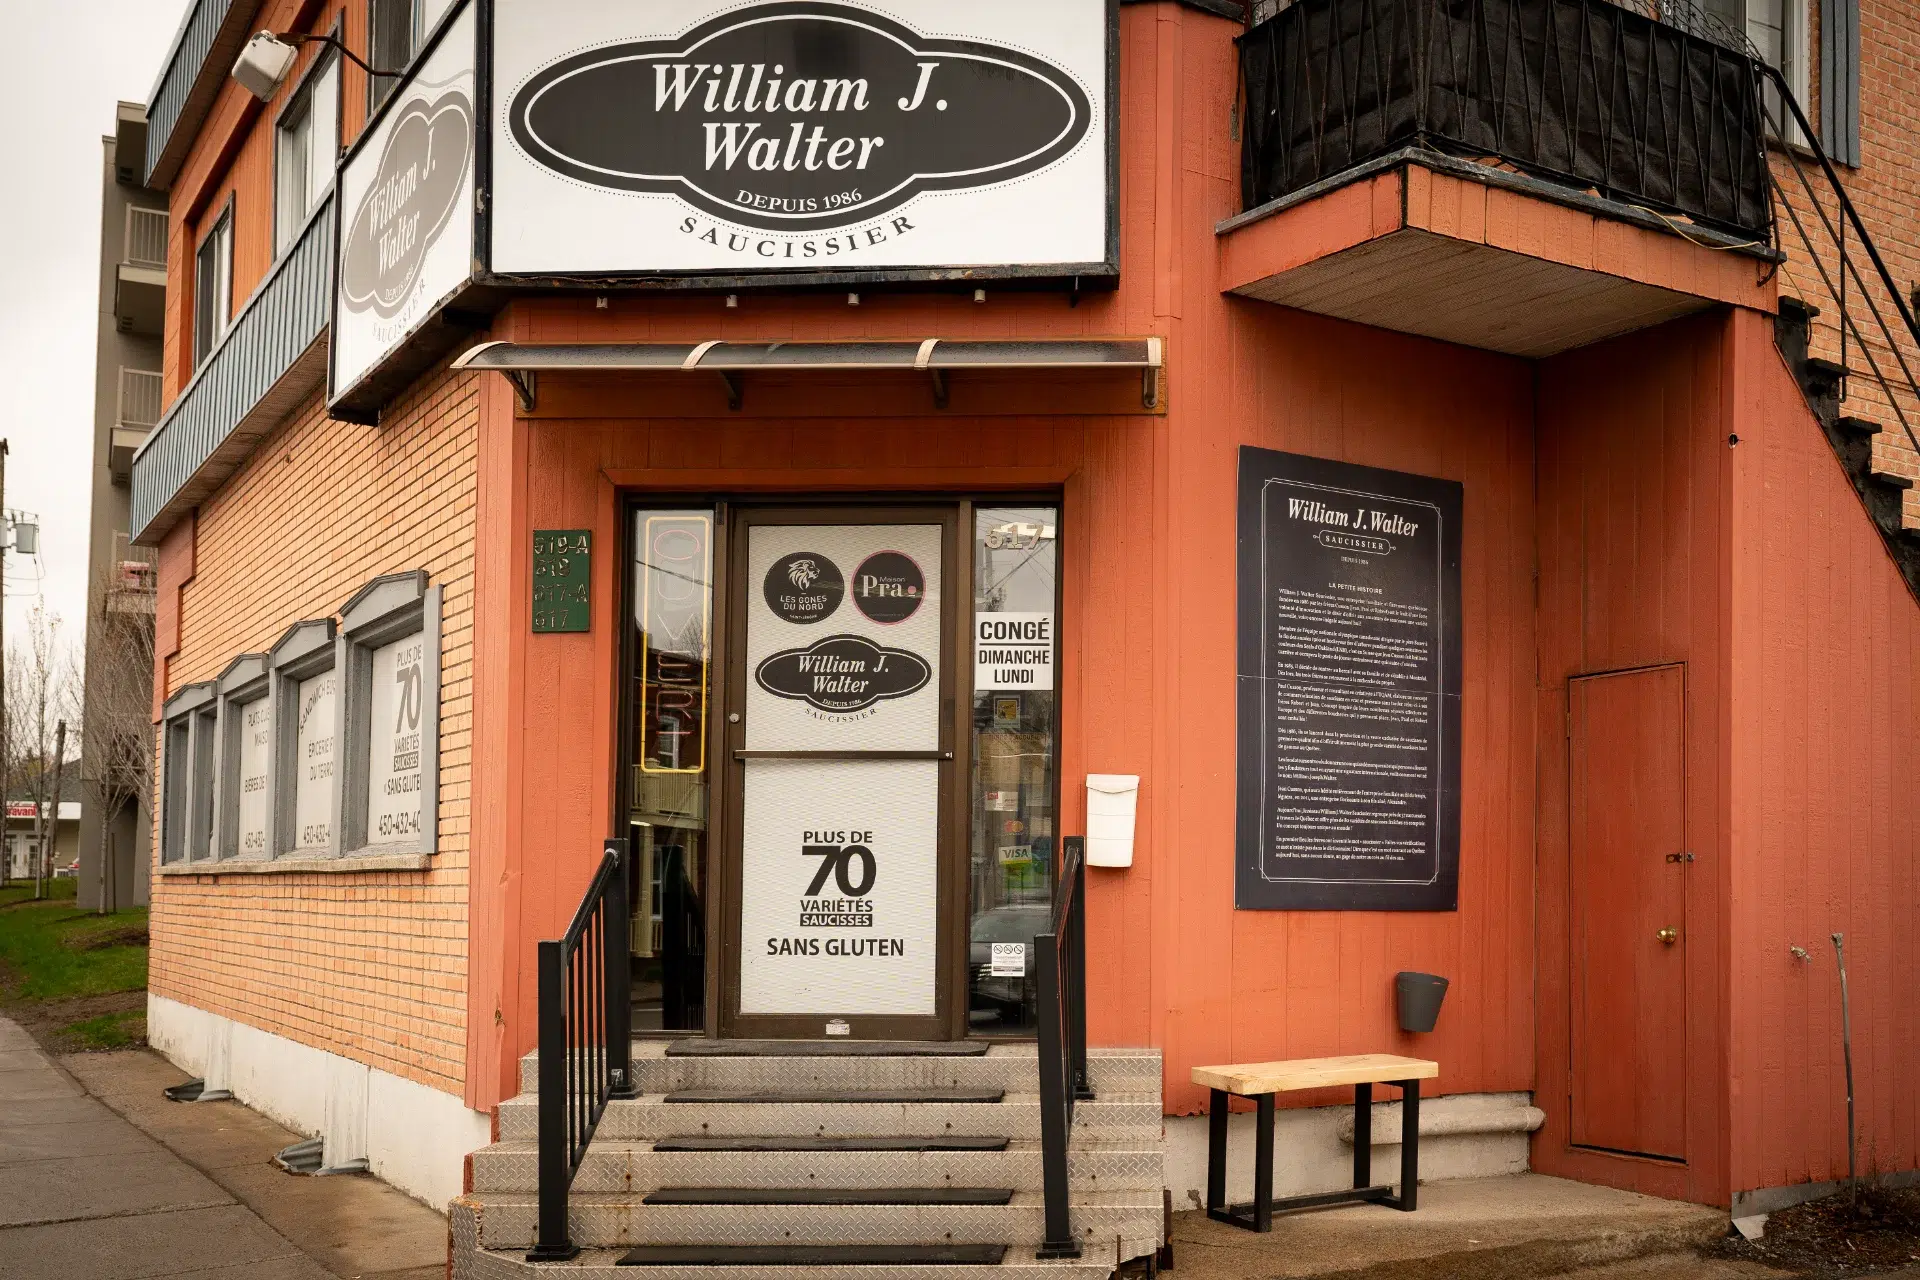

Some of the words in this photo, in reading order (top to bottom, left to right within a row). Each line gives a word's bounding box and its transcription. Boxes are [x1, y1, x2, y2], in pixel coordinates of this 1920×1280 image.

[652, 63, 869, 112] William
[898, 62, 948, 111] J.
[422, 126, 436, 181] J.
[701, 122, 884, 172] Walter
[370, 163, 418, 241] William
[736, 188, 818, 212] DEPUIS
[822, 188, 863, 210] 1986
[378, 211, 420, 279] Walter
[680, 215, 916, 258] SAUCISSIER
[1288, 498, 1348, 526] William
[1353, 509, 1367, 530] J.
[1370, 510, 1418, 536] Walter
[984, 524, 1044, 550] 617
[1326, 536, 1384, 550] SAUCISSIER
[780, 594, 796, 604] LES
[798, 594, 828, 604] GONES
[798, 603, 824, 611] NORD
[536, 610, 568, 628] 617
[980, 618, 1050, 640] CONGÉ
[397, 648, 412, 668] PLUS
[413, 644, 422, 660] DE
[798, 655, 866, 674] William
[873, 656, 888, 673] J.
[978, 650, 1050, 664] DIMANCHE
[812, 676, 869, 694] Walter
[994, 669, 1034, 684] LUNDI
[396, 663, 422, 734] 70
[822, 698, 848, 708] DEPUIS
[248, 708, 260, 728] PLATS
[804, 707, 878, 723] SAUCISSIER
[308, 738, 329, 758] ÉPICERIE
[394, 732, 420, 754] VARIÉTÉS
[310, 764, 316, 780] DU
[394, 754, 418, 771] SAUCISSES
[245, 776, 258, 793] BIÈRES
[259, 775, 265, 790] DE
[387, 777, 402, 796] SANS
[804, 831, 844, 843] PLUS
[850, 831, 873, 843] DE
[1002, 848, 1028, 858] VISA
[802, 844, 877, 897] 70
[800, 898, 873, 912] VARIÉTÉS
[802, 914, 870, 926] SAUCISSES
[767, 938, 820, 956] SANS
[825, 938, 904, 956] GLUTEN
